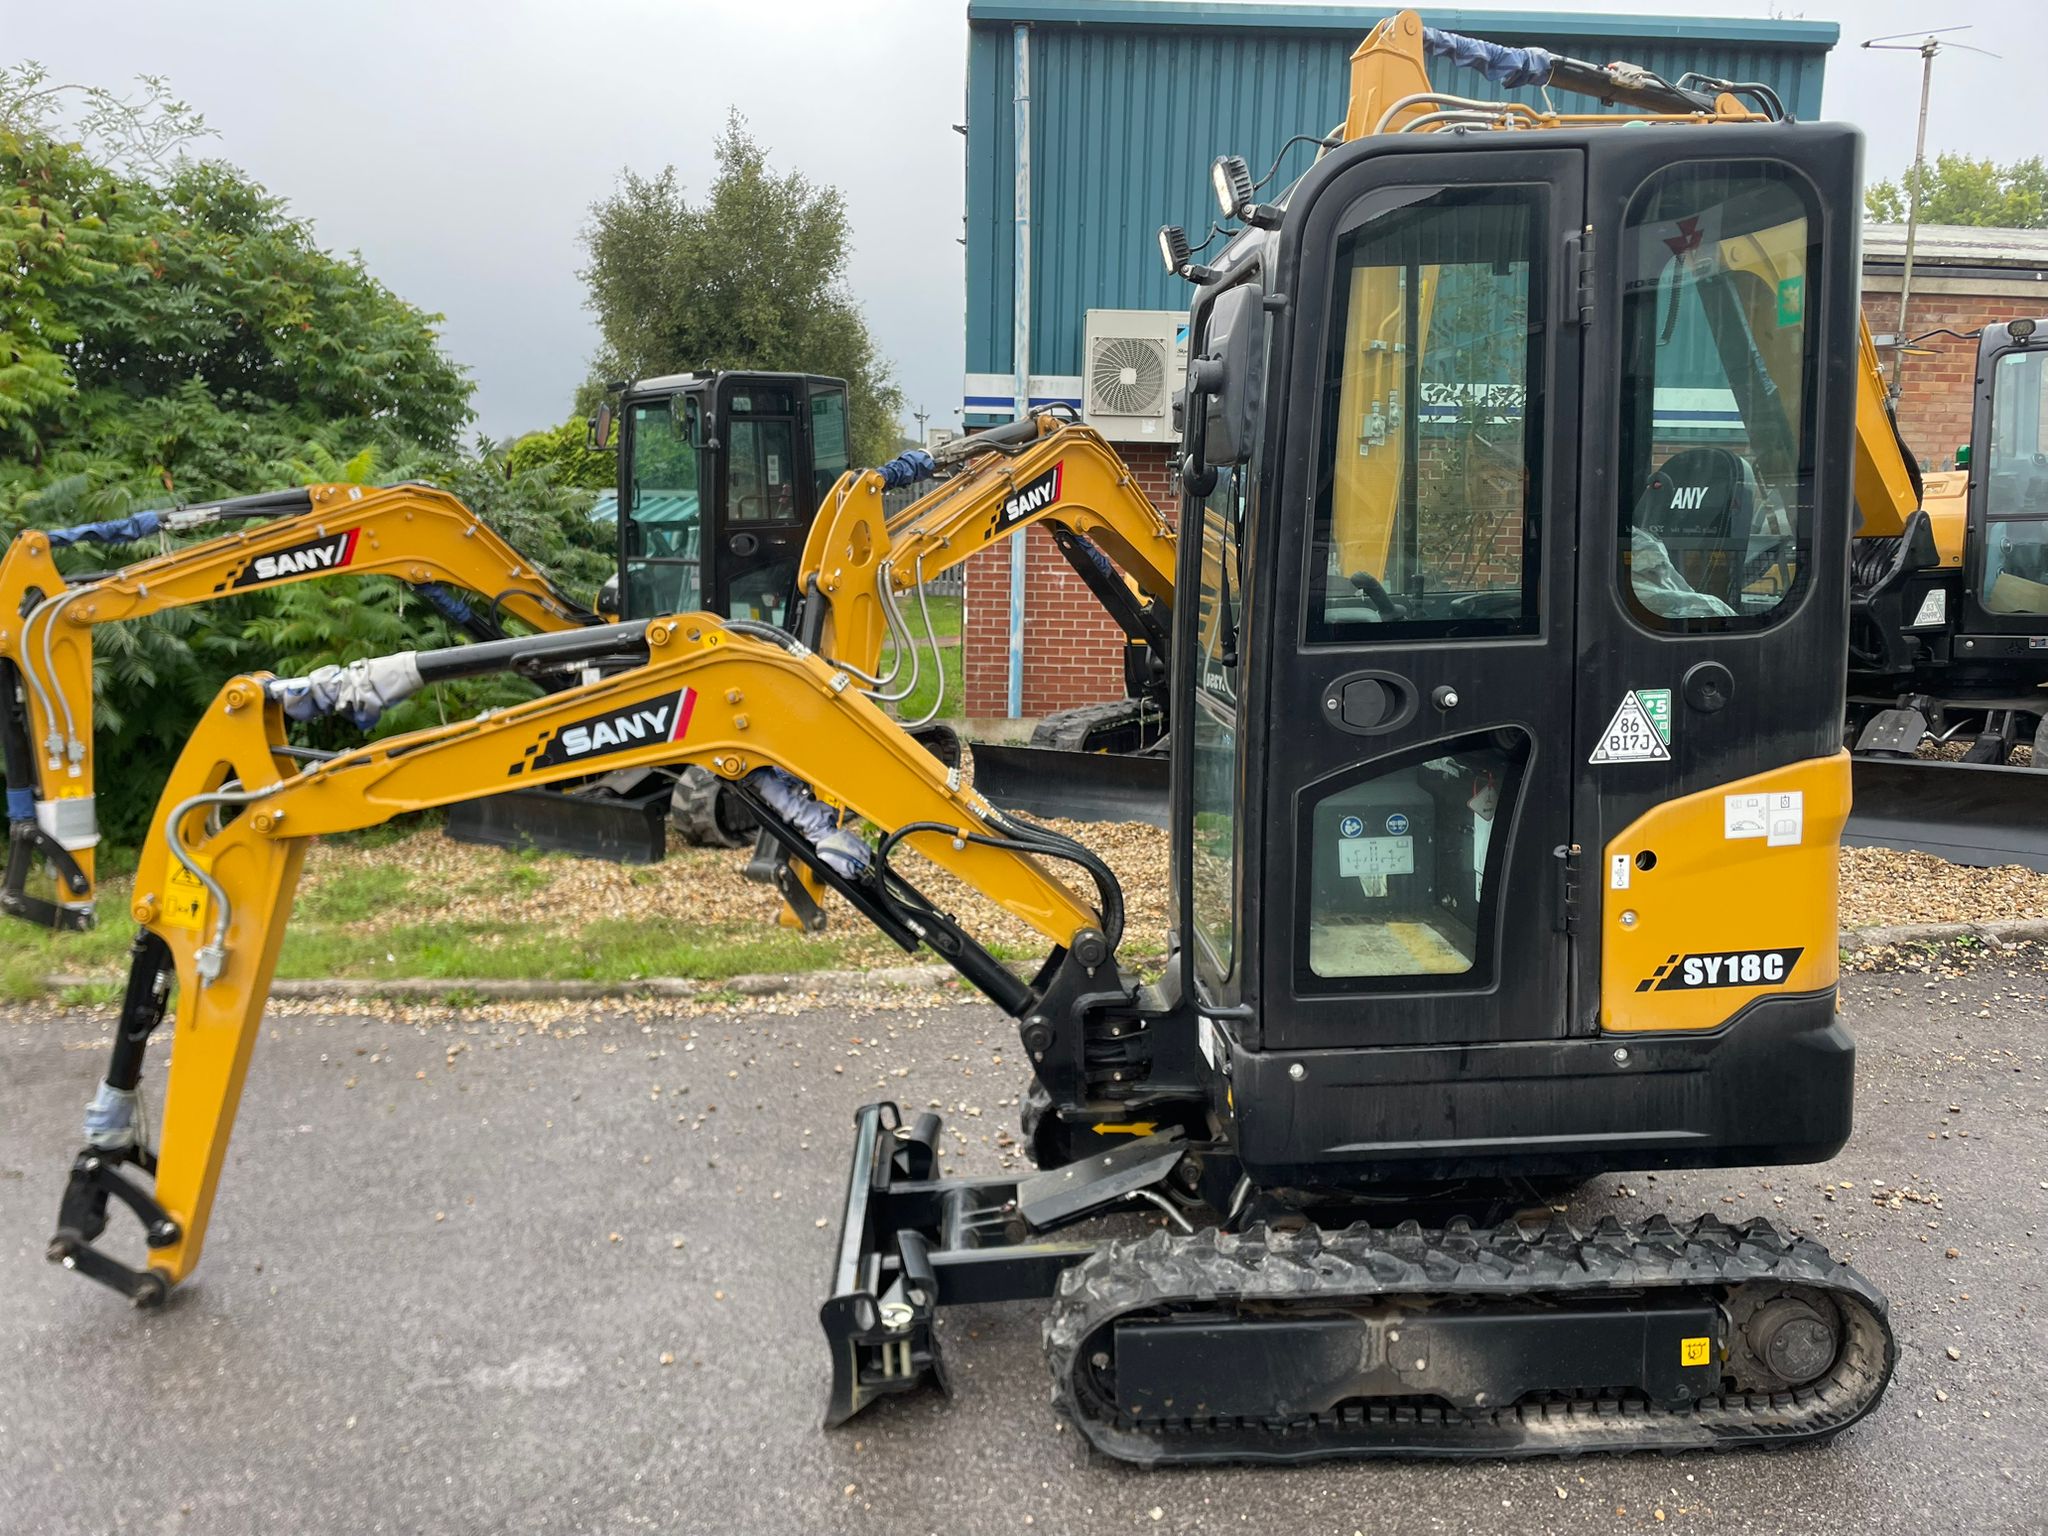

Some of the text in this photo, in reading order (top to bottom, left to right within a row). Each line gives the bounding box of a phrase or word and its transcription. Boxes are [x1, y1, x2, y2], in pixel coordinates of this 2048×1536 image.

[1006, 482, 1052, 520] SANY
[1670, 486, 1709, 509] ANY
[254, 545, 336, 579] SANY
[1655, 699, 1667, 713] 5
[562, 705, 669, 757] SANY
[1620, 716, 1640, 734] 86
[1683, 952, 1785, 986] SY18C
